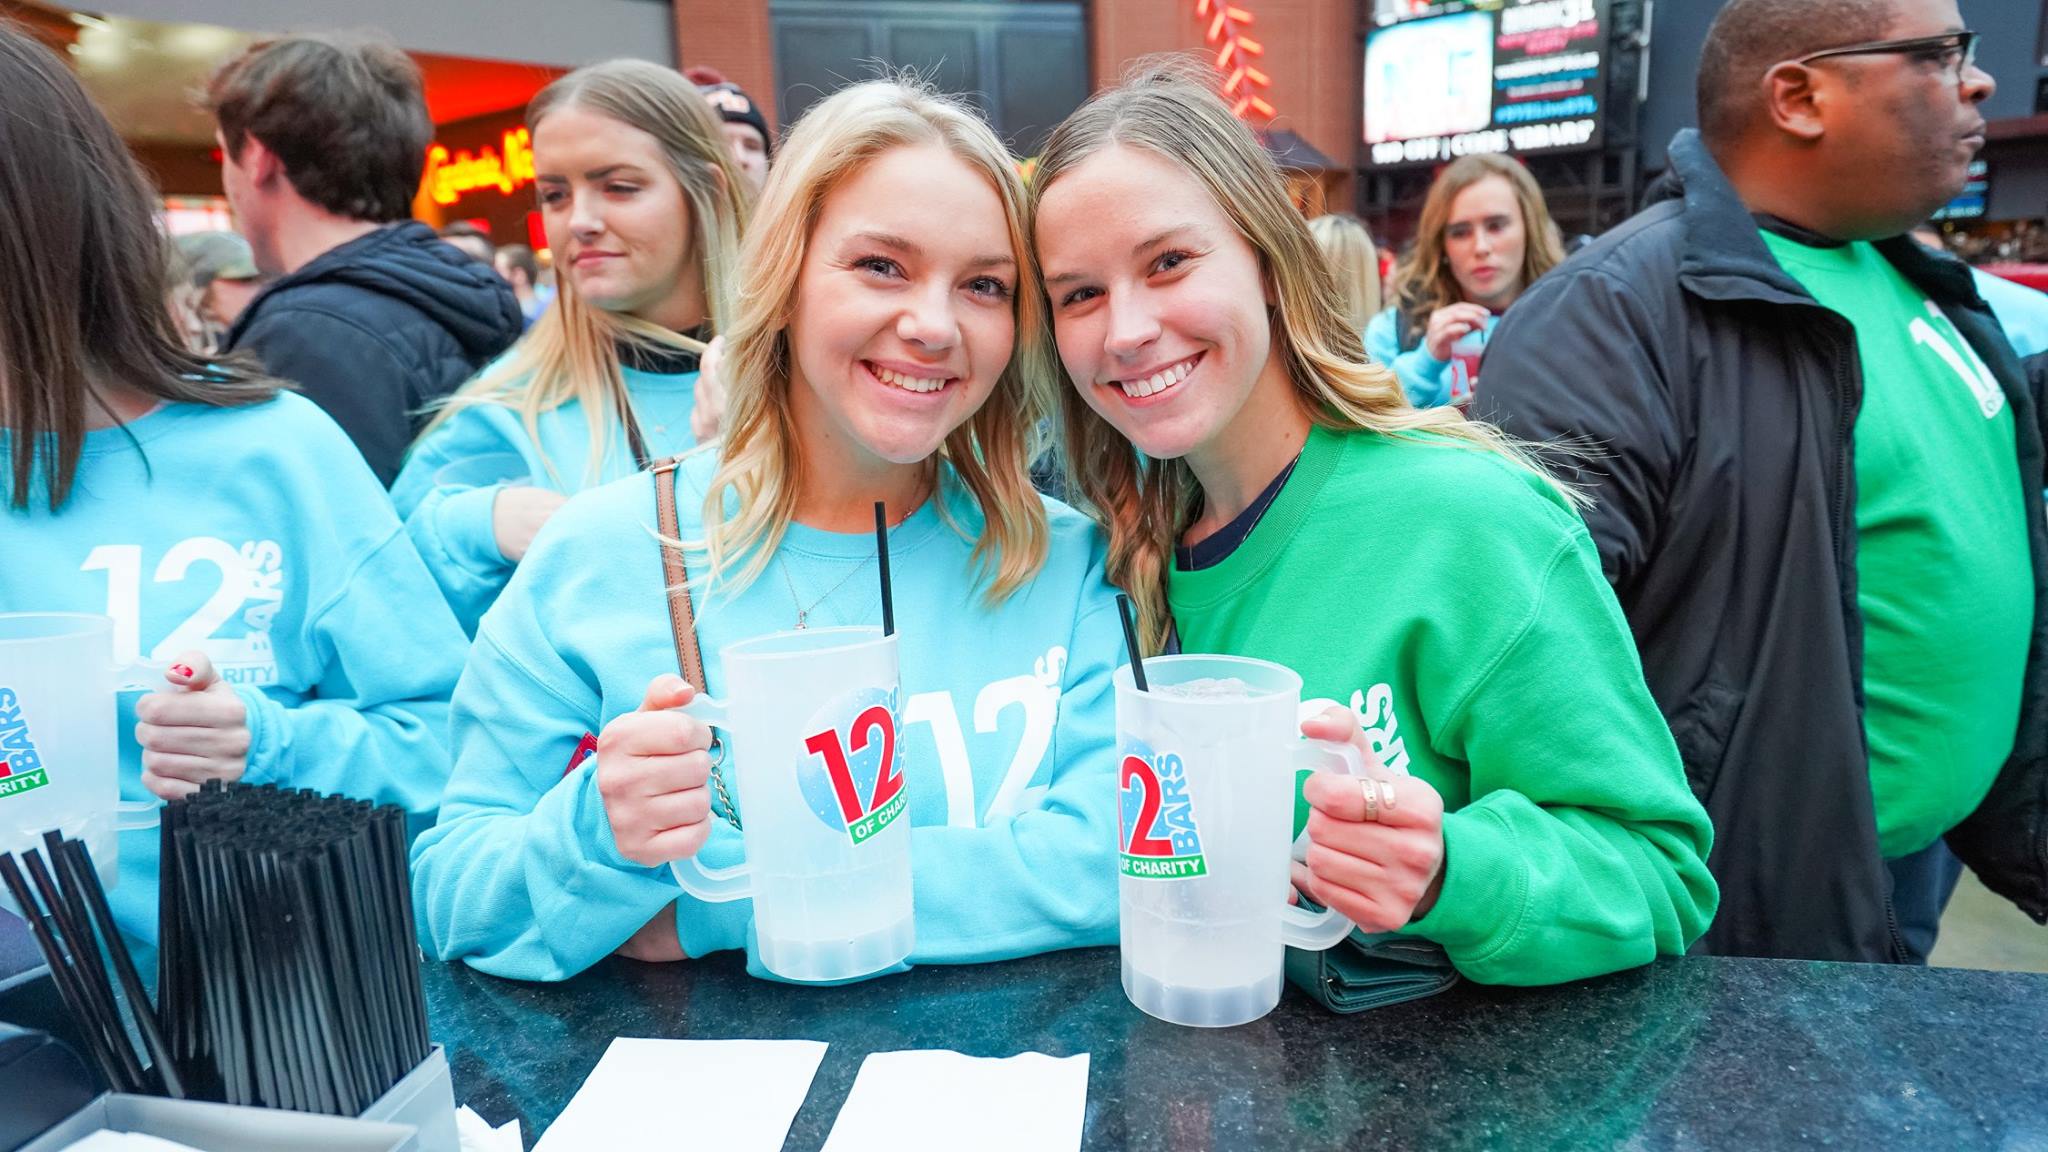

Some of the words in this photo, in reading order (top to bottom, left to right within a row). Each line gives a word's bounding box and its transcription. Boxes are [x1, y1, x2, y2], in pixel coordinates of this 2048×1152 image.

[80, 536, 250, 666] 12
[240, 540, 283, 652] BARS
[223, 666, 274, 684] RITY
[0, 772, 43, 795] RITY
[805, 706, 904, 824] 12
[904, 674, 1057, 829] 12
[855, 818, 875, 839] OF
[877, 791, 908, 825] CHAR
[1157, 753, 1202, 855] BARS
[1121, 858, 1130, 872] OF
[1133, 859, 1201, 875] CHARITY
